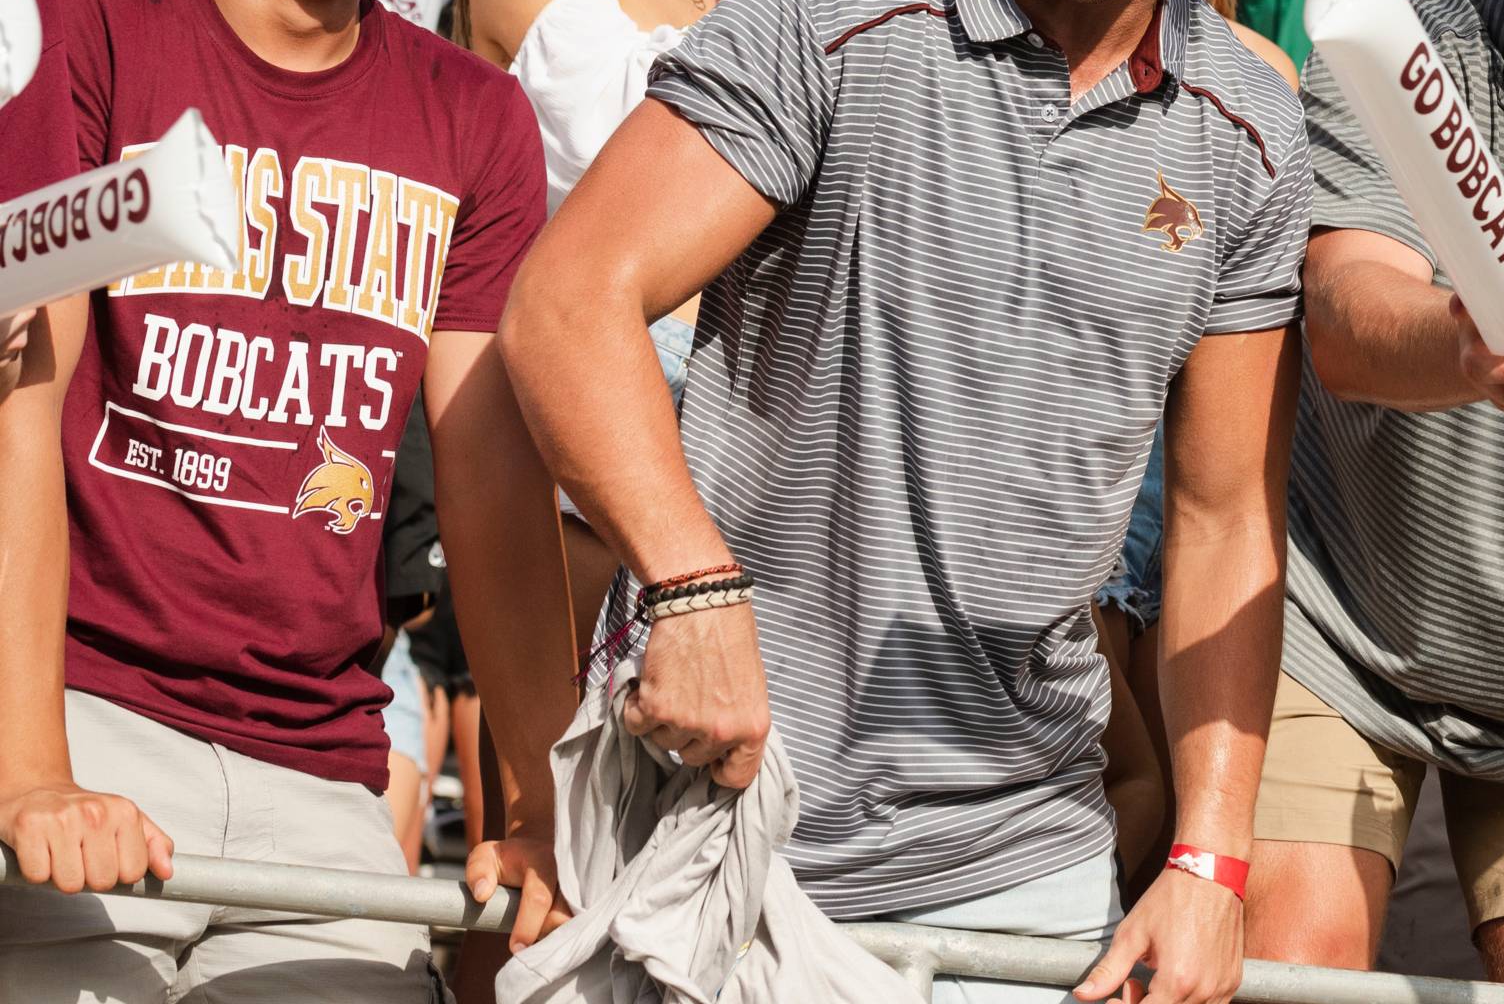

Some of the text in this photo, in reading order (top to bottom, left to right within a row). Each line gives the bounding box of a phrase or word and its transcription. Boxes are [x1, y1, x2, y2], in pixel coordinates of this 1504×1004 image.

[1400, 41, 1444, 115] GO
[97, 168, 151, 232] GO
[132, 313, 397, 431] BOBCATS
[124, 438, 233, 492] EST. 1899
